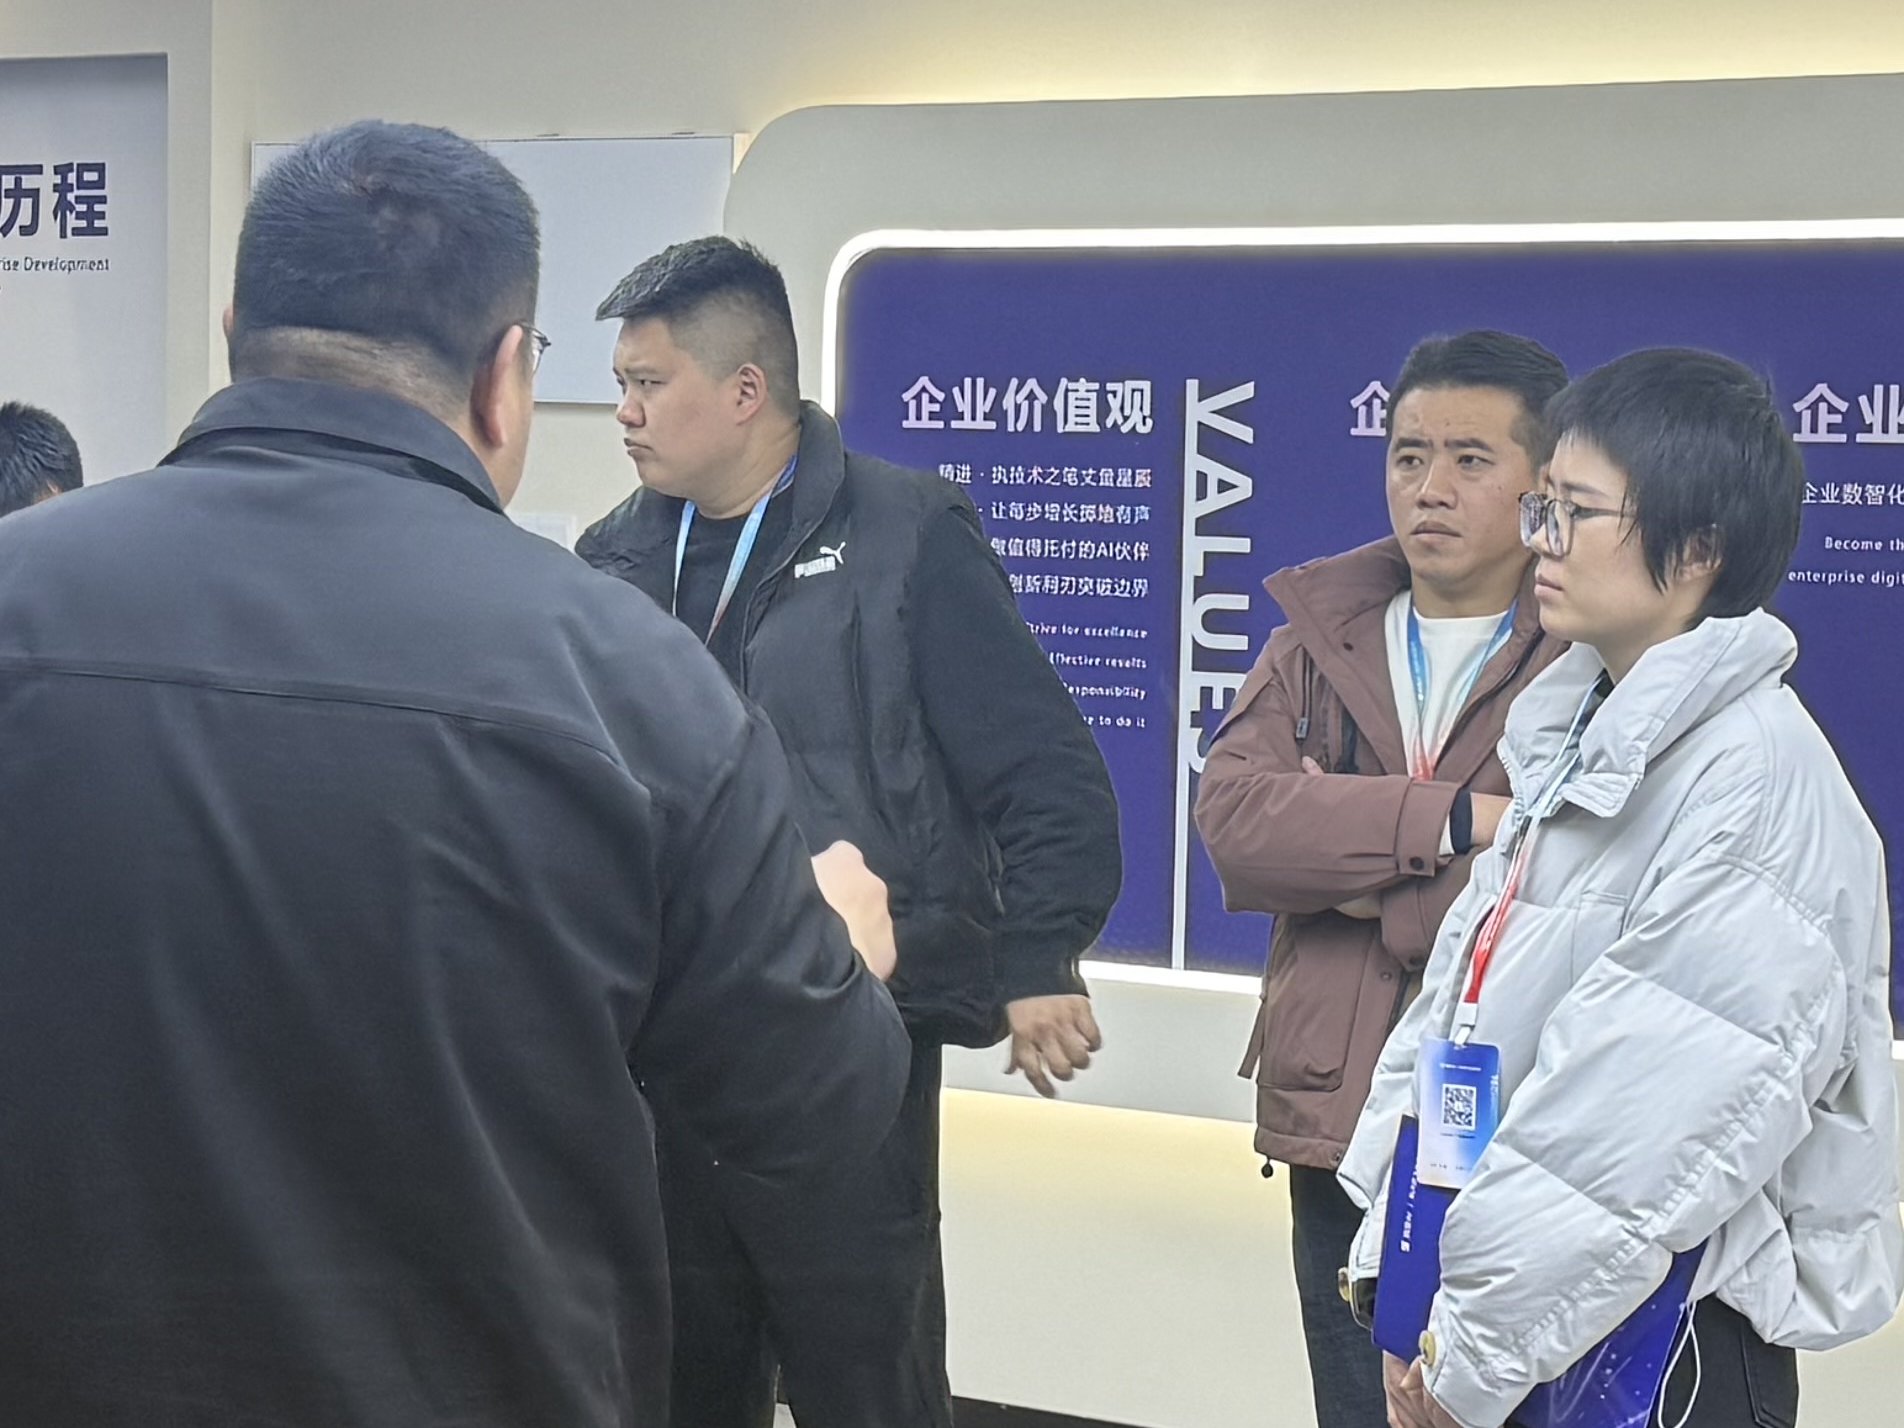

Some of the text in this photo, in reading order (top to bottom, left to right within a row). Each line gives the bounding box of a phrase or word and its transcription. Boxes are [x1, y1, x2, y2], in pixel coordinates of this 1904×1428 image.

[22, 256, 110, 275] Development
[901, 375, 1153, 435] 企业价值观
[1824, 536, 1884, 552] Become
[1192, 380, 1255, 775] VALUE
[1787, 569, 1866, 585] enterprise
